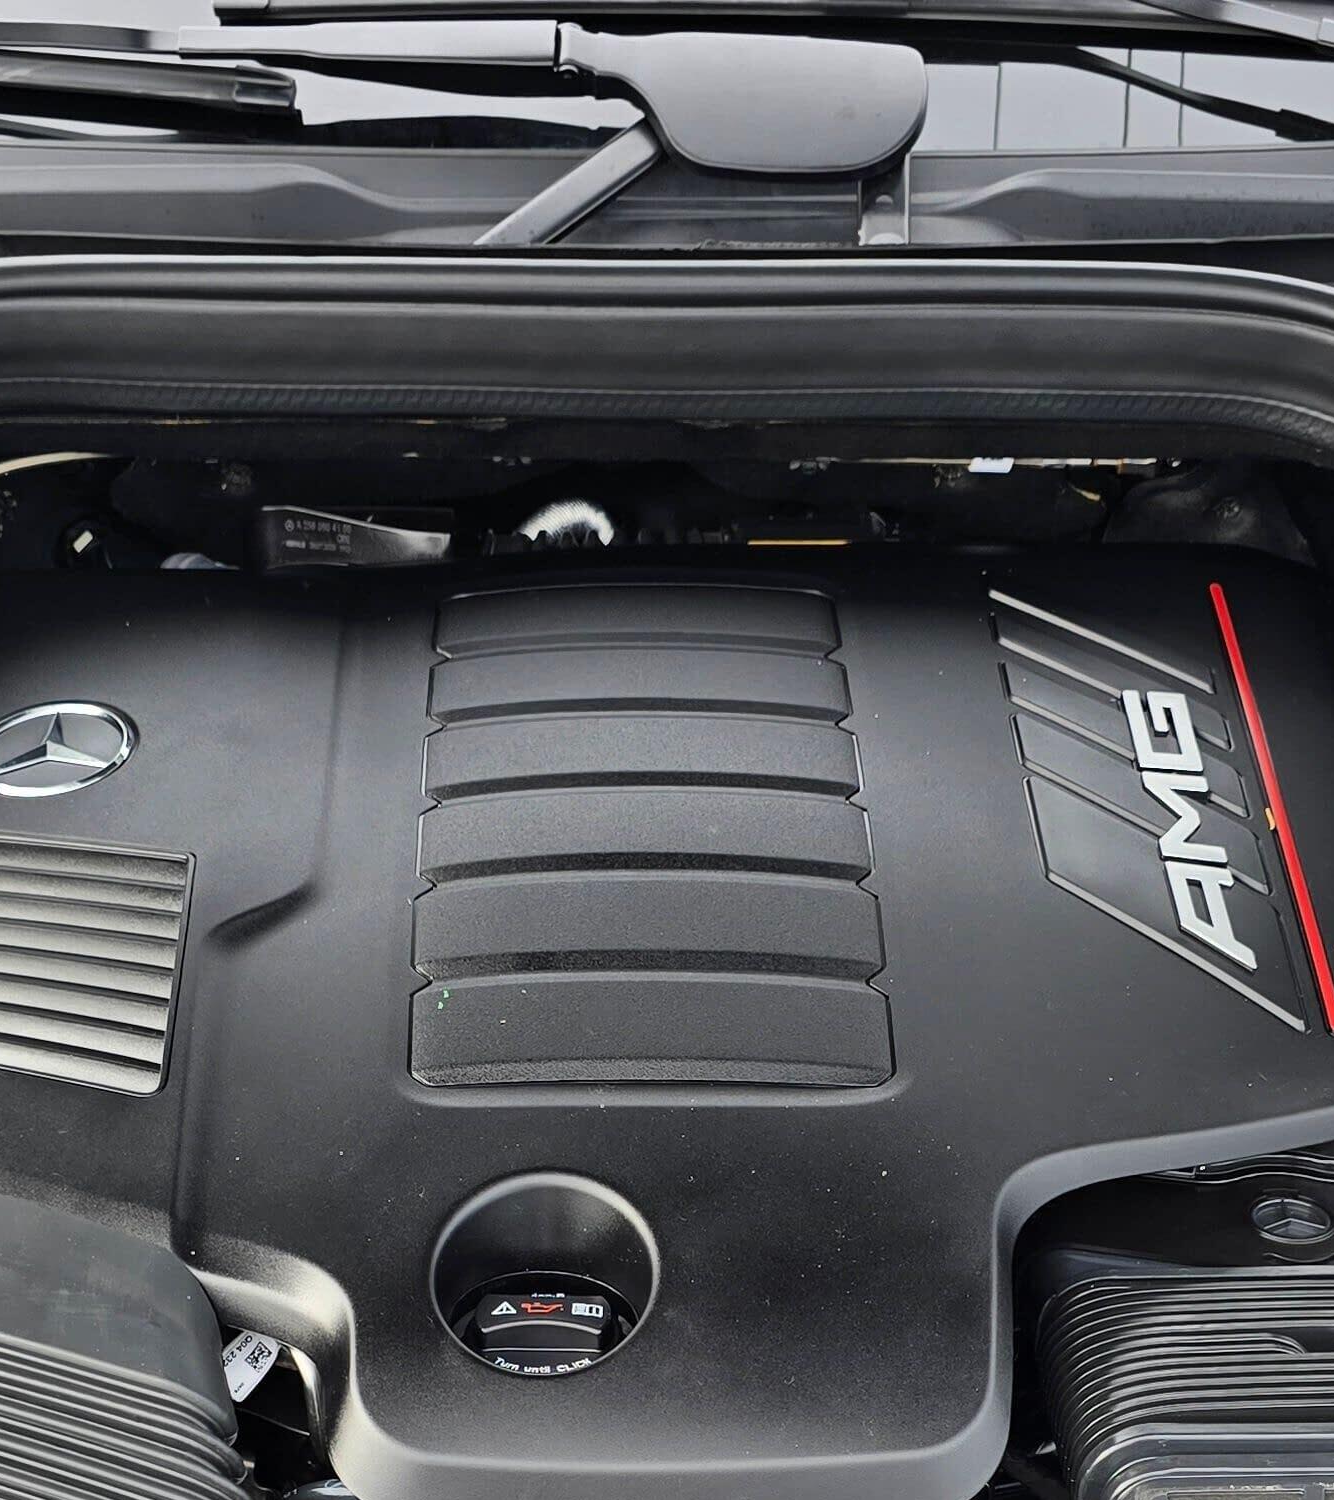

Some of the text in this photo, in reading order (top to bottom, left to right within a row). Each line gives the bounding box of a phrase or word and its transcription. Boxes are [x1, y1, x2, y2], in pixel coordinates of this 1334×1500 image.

[1122, 690, 1257, 971] AMG
[494, 1356, 593, 1373] Turn until CLICK
